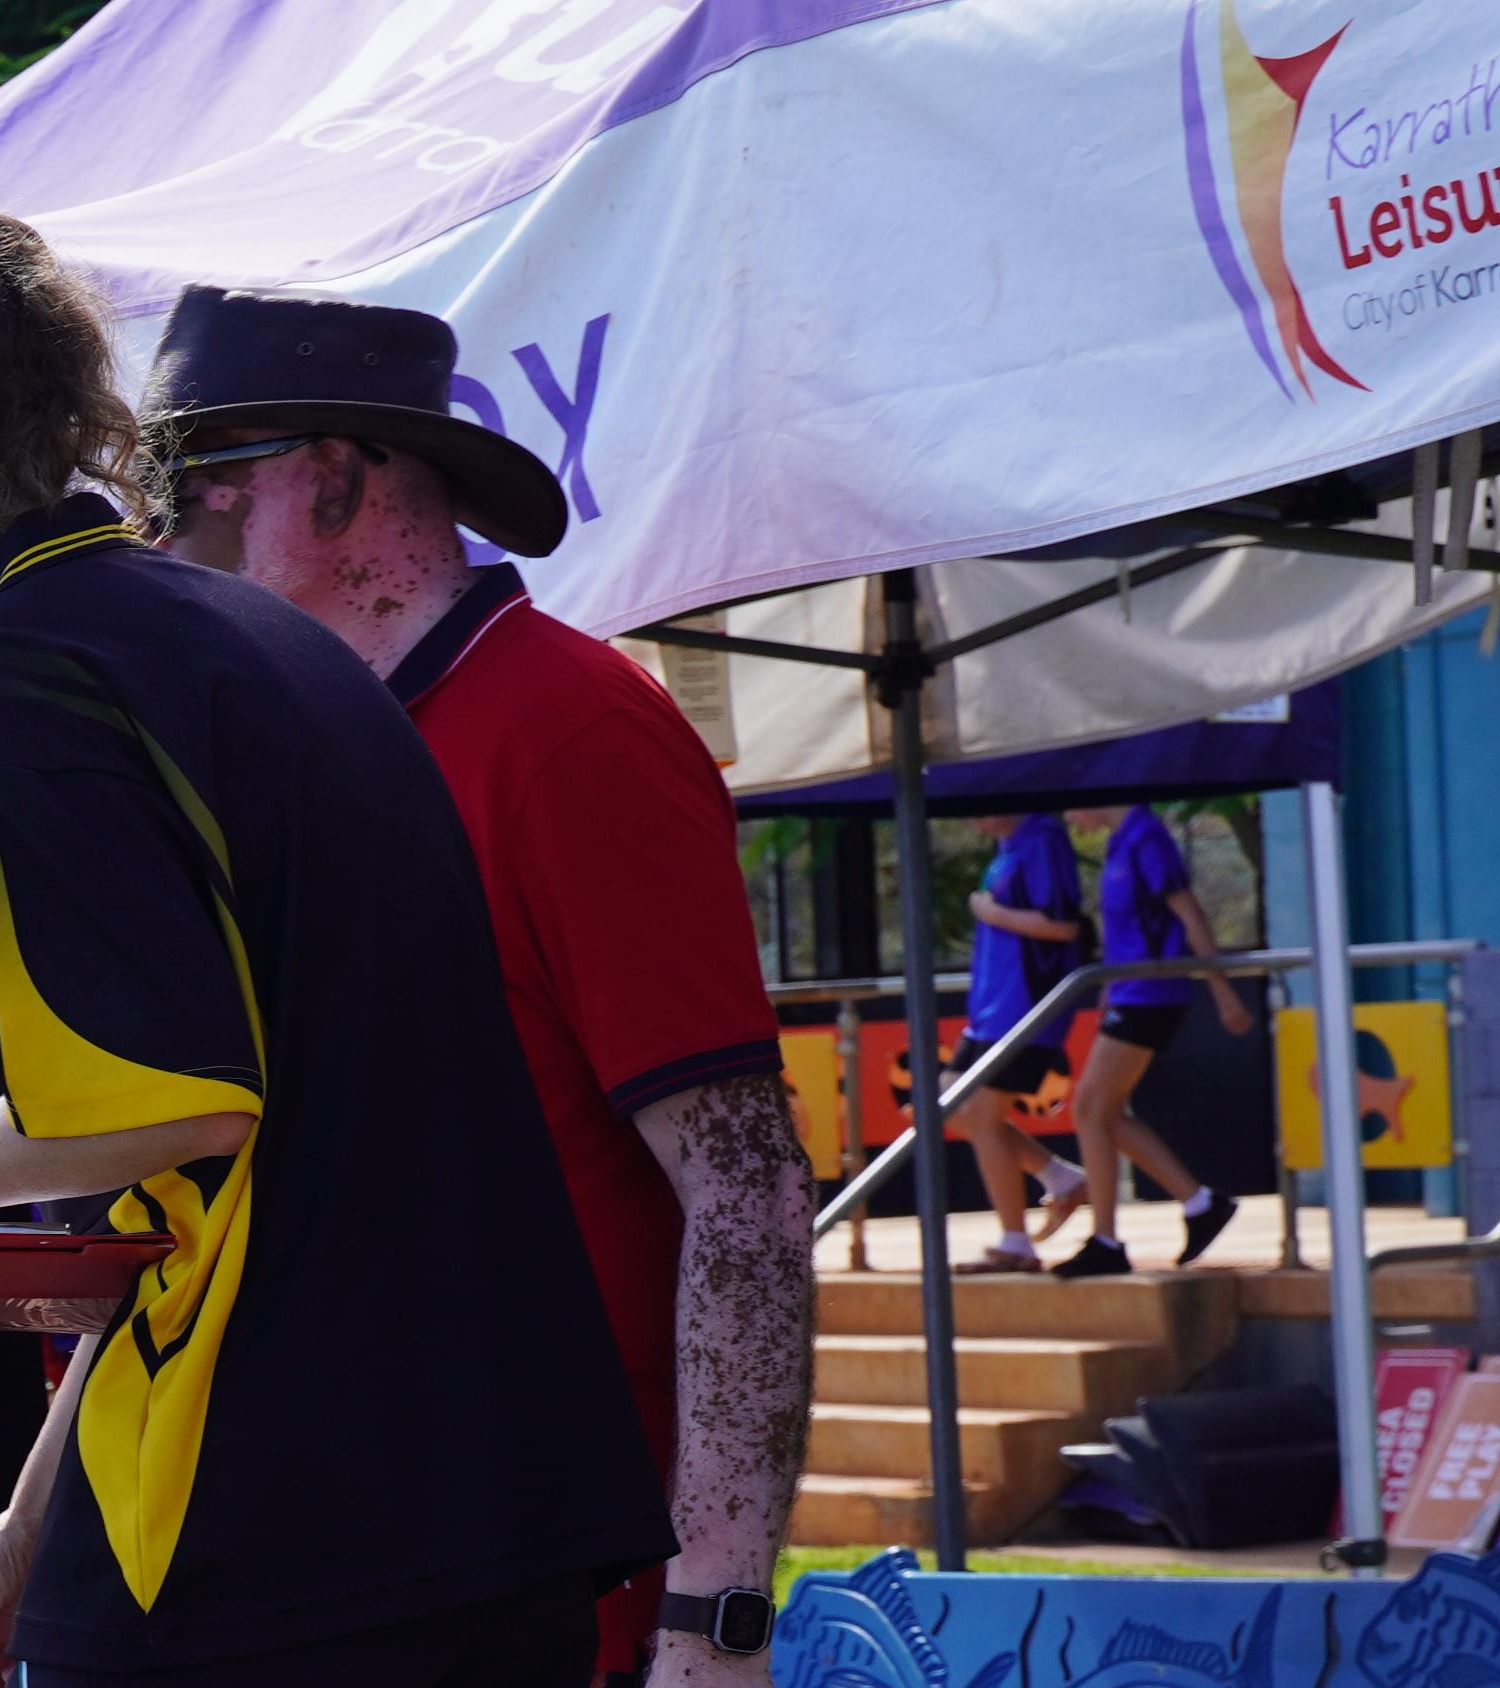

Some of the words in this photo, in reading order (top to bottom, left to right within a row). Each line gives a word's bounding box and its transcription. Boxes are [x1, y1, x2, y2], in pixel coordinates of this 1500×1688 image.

[1343, 288, 1396, 332] City
[1399, 273, 1427, 316] of
[1380, 1386, 1436, 1512] CLOSED
[1427, 1422, 1483, 1500] FREE
